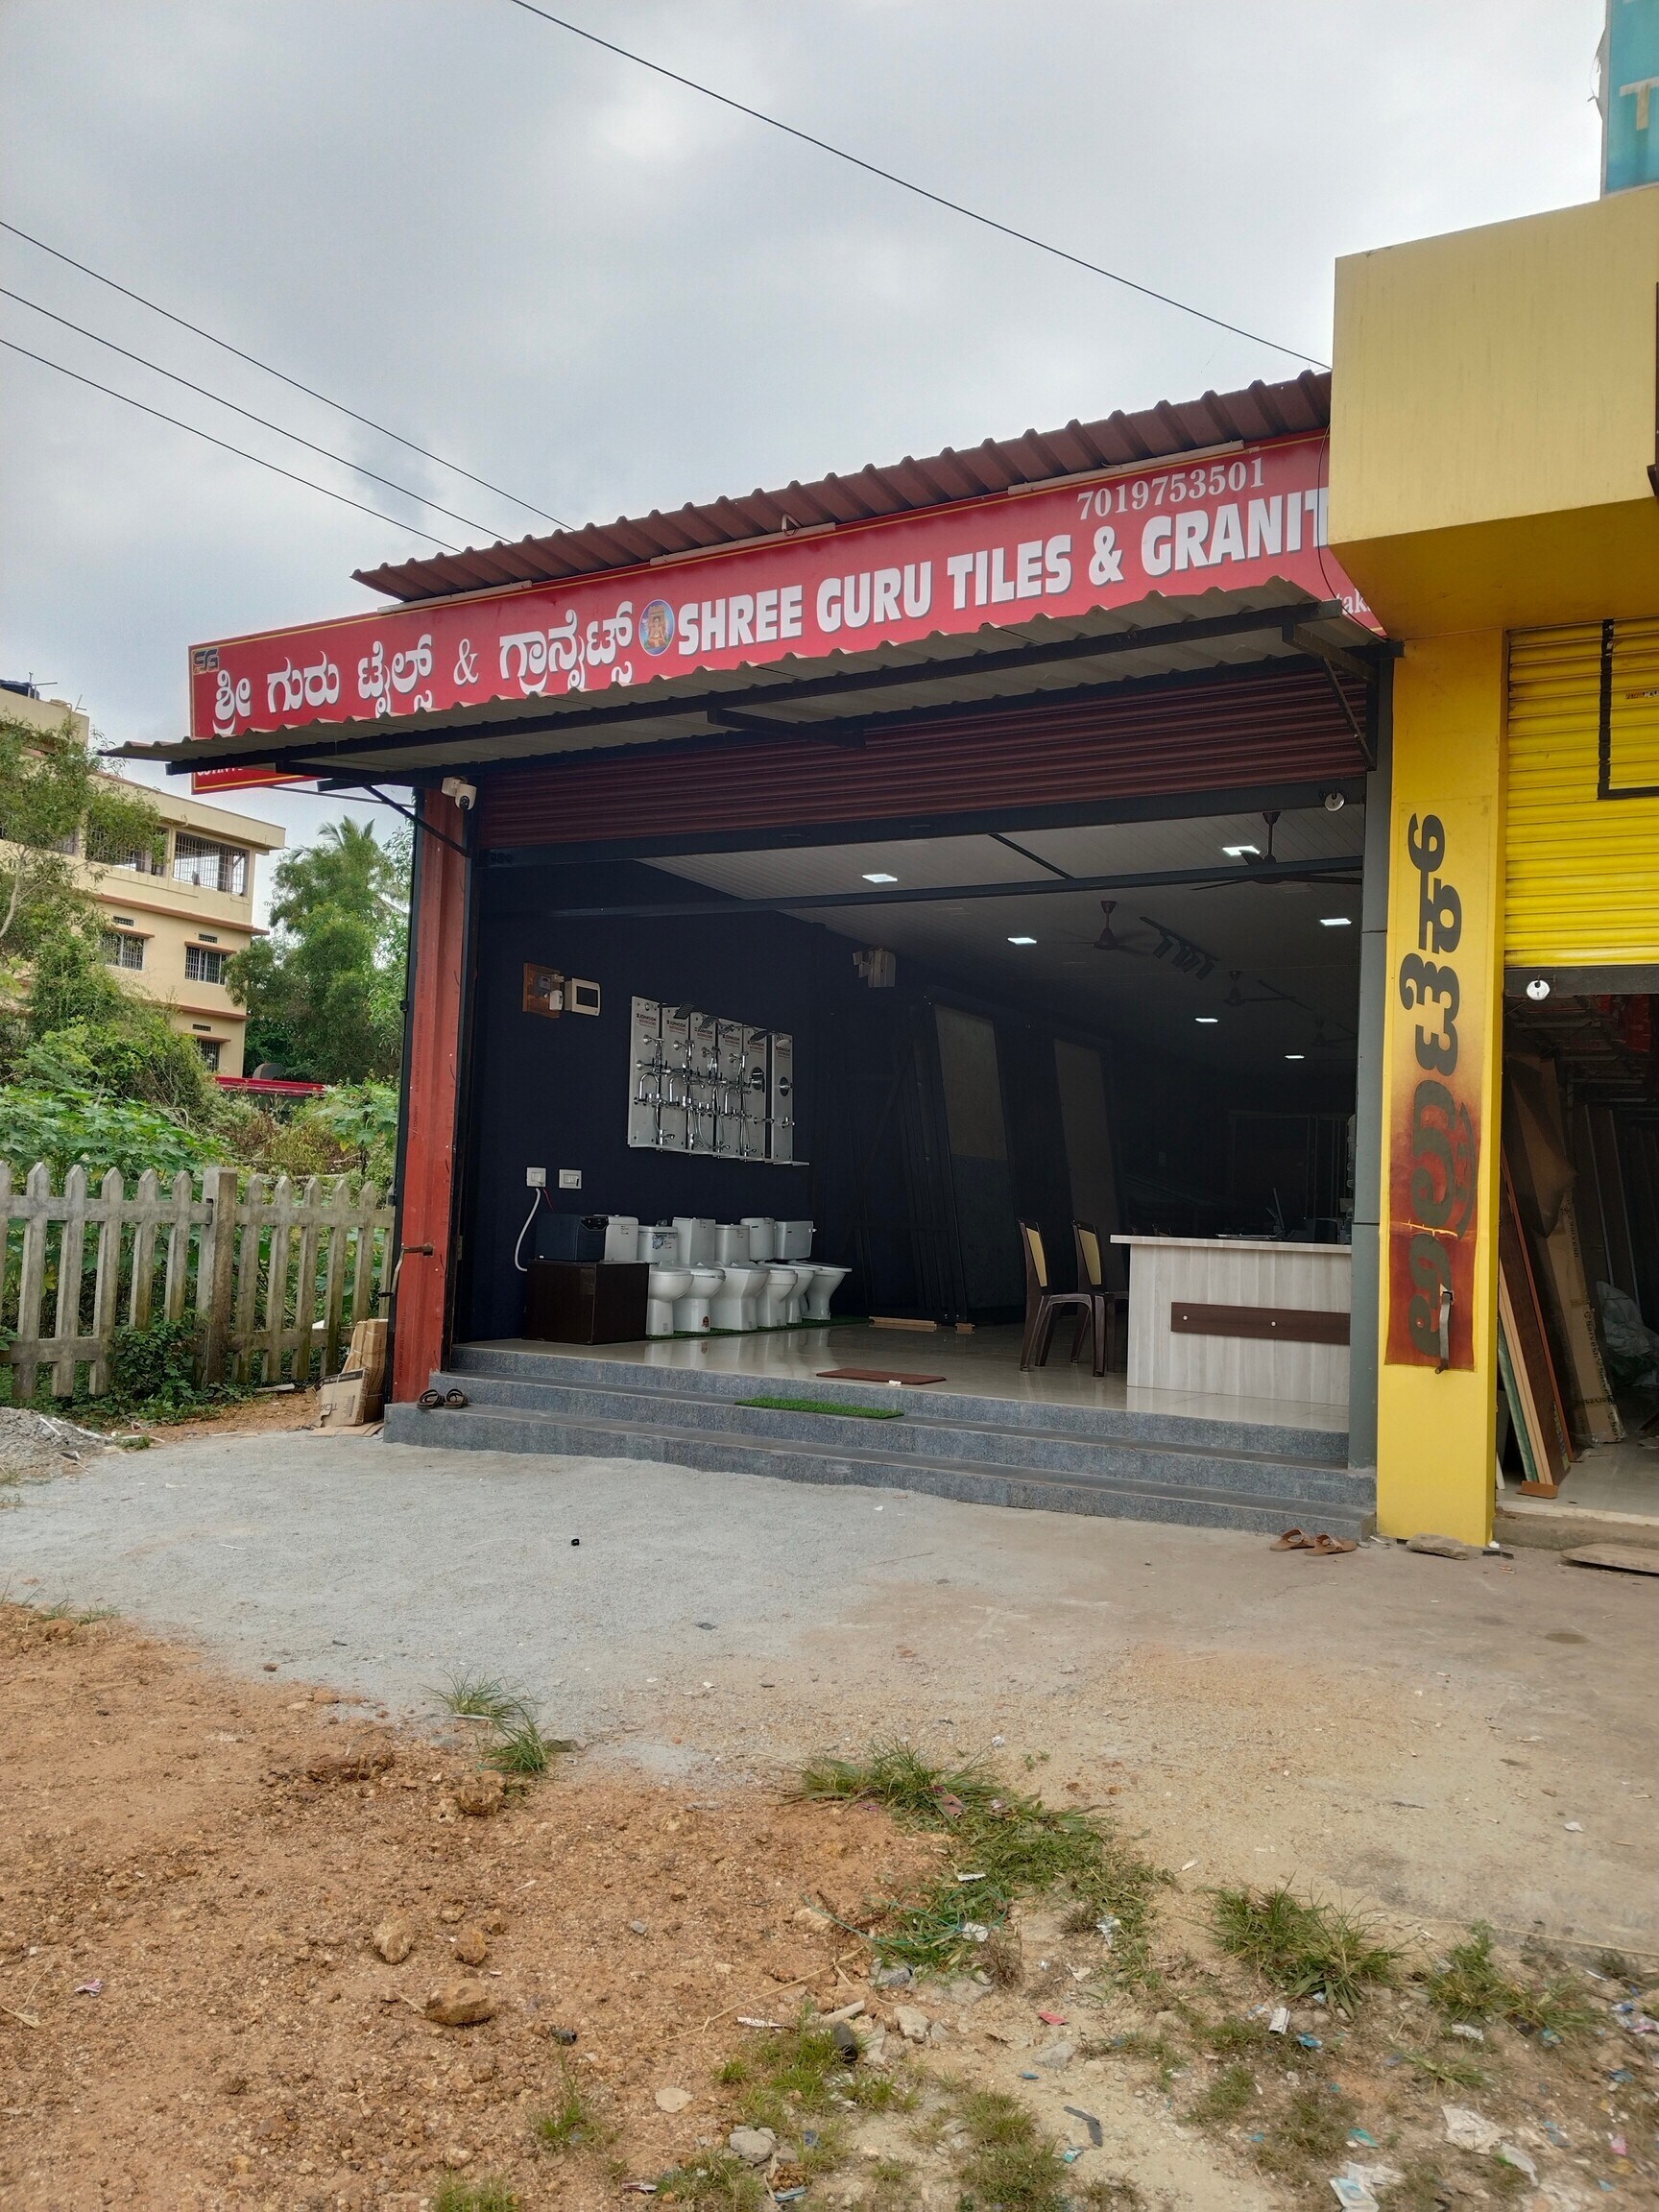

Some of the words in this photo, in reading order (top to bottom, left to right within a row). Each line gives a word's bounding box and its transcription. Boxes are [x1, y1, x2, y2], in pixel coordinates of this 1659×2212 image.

[1076, 457, 1265, 520] 7019753501
[678, 583, 803, 656] SHREE
[816, 562, 932, 633] GURU
[948, 534, 1071, 610] TILES
[1089, 525, 1124, 586] &
[212, 669, 251, 735] ಶ್ರೀ
[267, 651, 340, 713] ಗುರು
[453, 638, 479, 685] &
